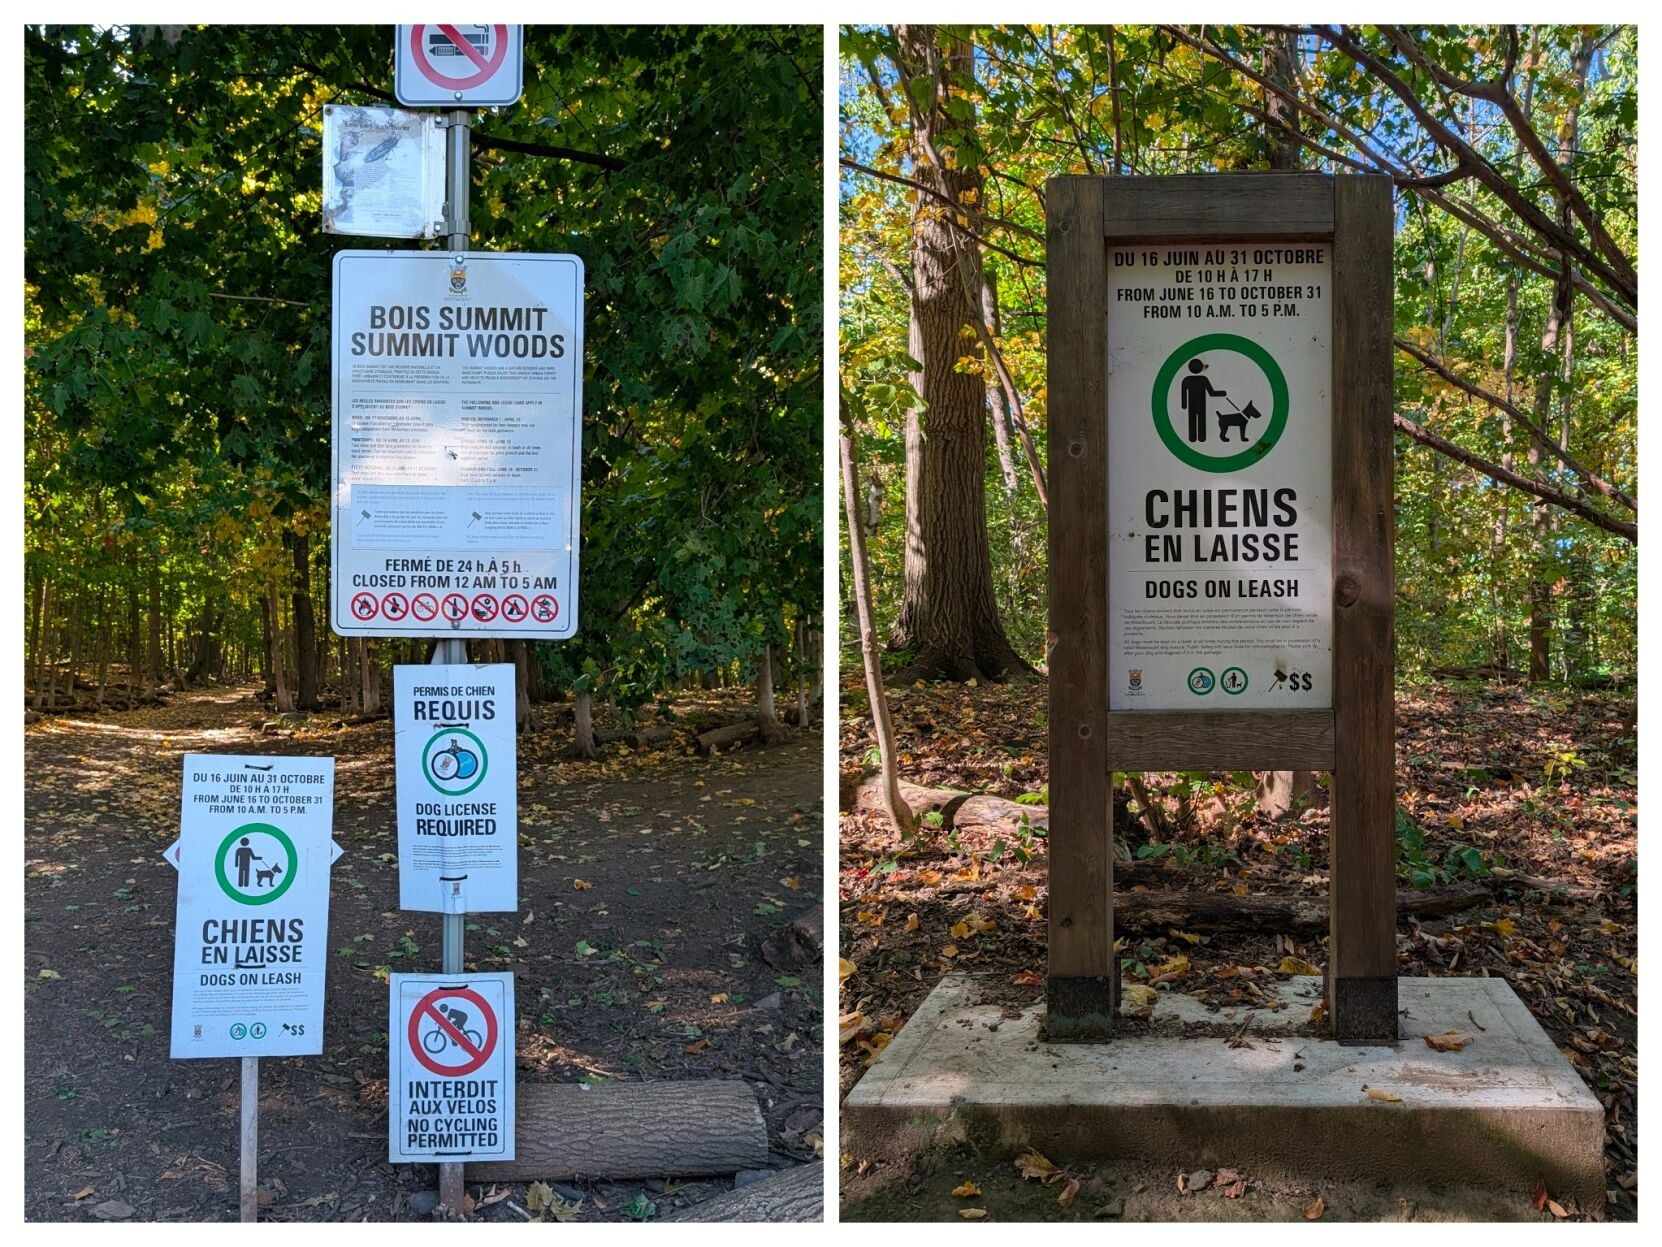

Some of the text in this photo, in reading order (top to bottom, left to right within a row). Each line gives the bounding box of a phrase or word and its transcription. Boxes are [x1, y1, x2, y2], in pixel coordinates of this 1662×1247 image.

[1115, 250, 1324, 267] DU 16 JUIN AU 31 OCTOBRE
[1176, 266, 1272, 283] DE 10 H À 17 H
[1117, 286, 1321, 301] FROM JUNE 16 TO OCTOBER 31
[370, 306, 548, 331] BOIS SUMMIT
[1143, 304, 1299, 318] FROM 10 A.M. TO 5 P.M.
[351, 332, 565, 358] SUMMIT WOODS
[1145, 488, 1297, 528] CHIENS
[1145, 533, 1299, 563] EN LAISSE
[386, 556, 522, 573] FERMÉ DE 24 h À 5 h
[353, 574, 557, 589] CLOSED FROM 12 AM TO 5 AM
[1145, 580, 1298, 599] DOGS ON LEASH
[414, 686, 495, 696] PERMIS DE CHIEN
[414, 700, 495, 721] REQUIS
[193, 773, 325, 784] DU 16 JUIN AU 31 OCTOBRE
[229, 784, 241, 793] DE
[244, 784, 253, 793] 10
[255, 785, 261, 793] H
[272, 786, 281, 794] 17
[283, 786, 289, 794] H
[194, 794, 323, 804] FROM JUNE 16 TO OCTOBER 31
[209, 804, 234, 813] FROM
[237, 805, 246, 814] 10
[270, 805, 281, 814] TO
[283, 805, 288, 814] 5
[416, 803, 496, 816] DOG LICENSE
[417, 819, 496, 836] REQUIRED
[202, 919, 304, 944] CHIENS
[201, 946, 303, 964] EN LAISSE
[200, 973, 301, 986] DOGS ON LEASH
[409, 1080, 498, 1099] INTERDIT
[409, 1100, 441, 1115] AUX
[408, 1118, 497, 1132] NO CYCLING
[408, 1133, 498, 1148] PERMITTED
